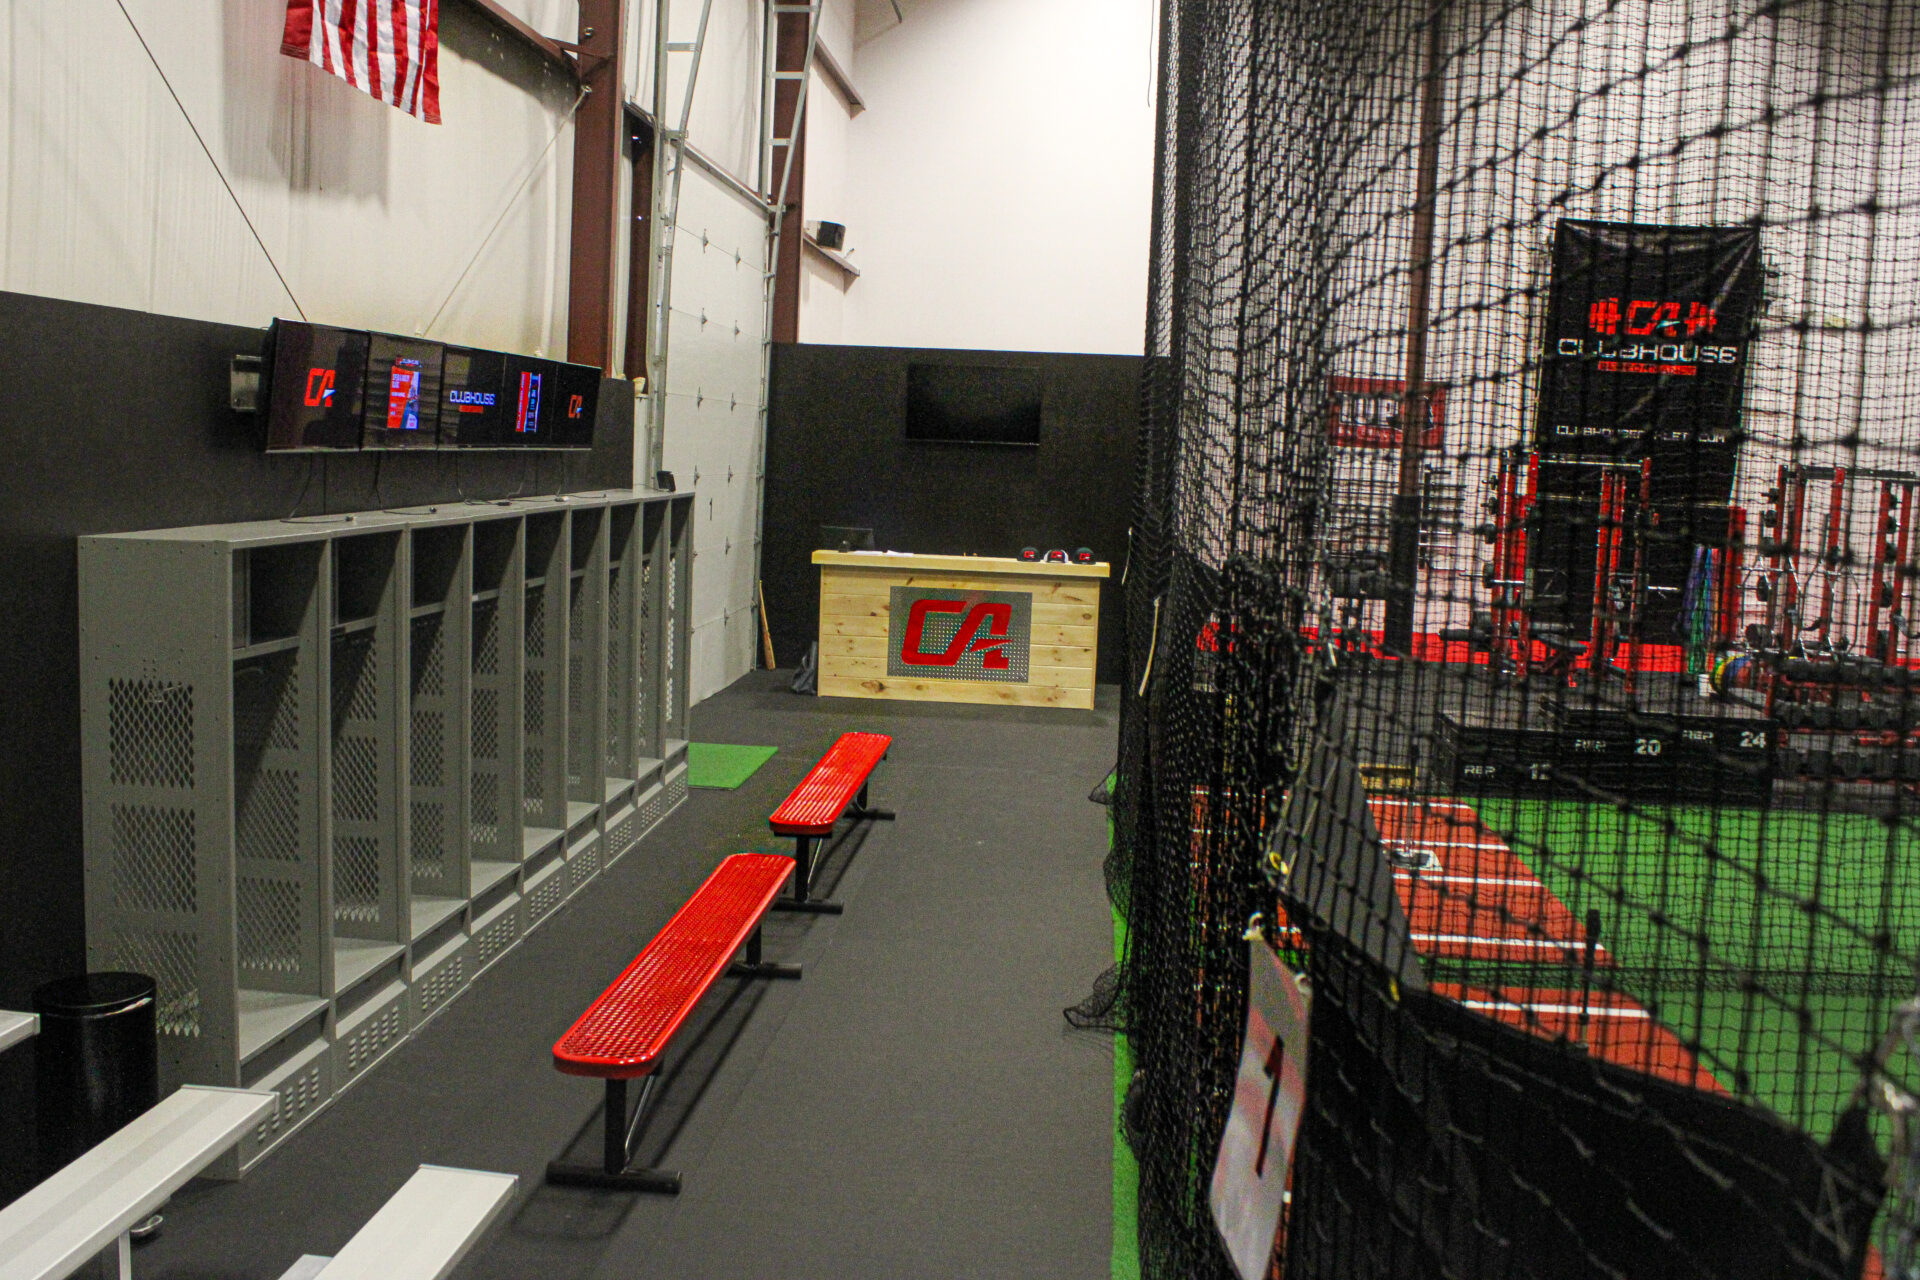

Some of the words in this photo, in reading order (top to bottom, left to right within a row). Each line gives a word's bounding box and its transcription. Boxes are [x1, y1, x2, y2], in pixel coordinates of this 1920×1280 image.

[449, 390, 495, 406] CLUBHOUSE
[1635, 739, 1662, 756] 20
[1740, 731, 1767, 748] 24
